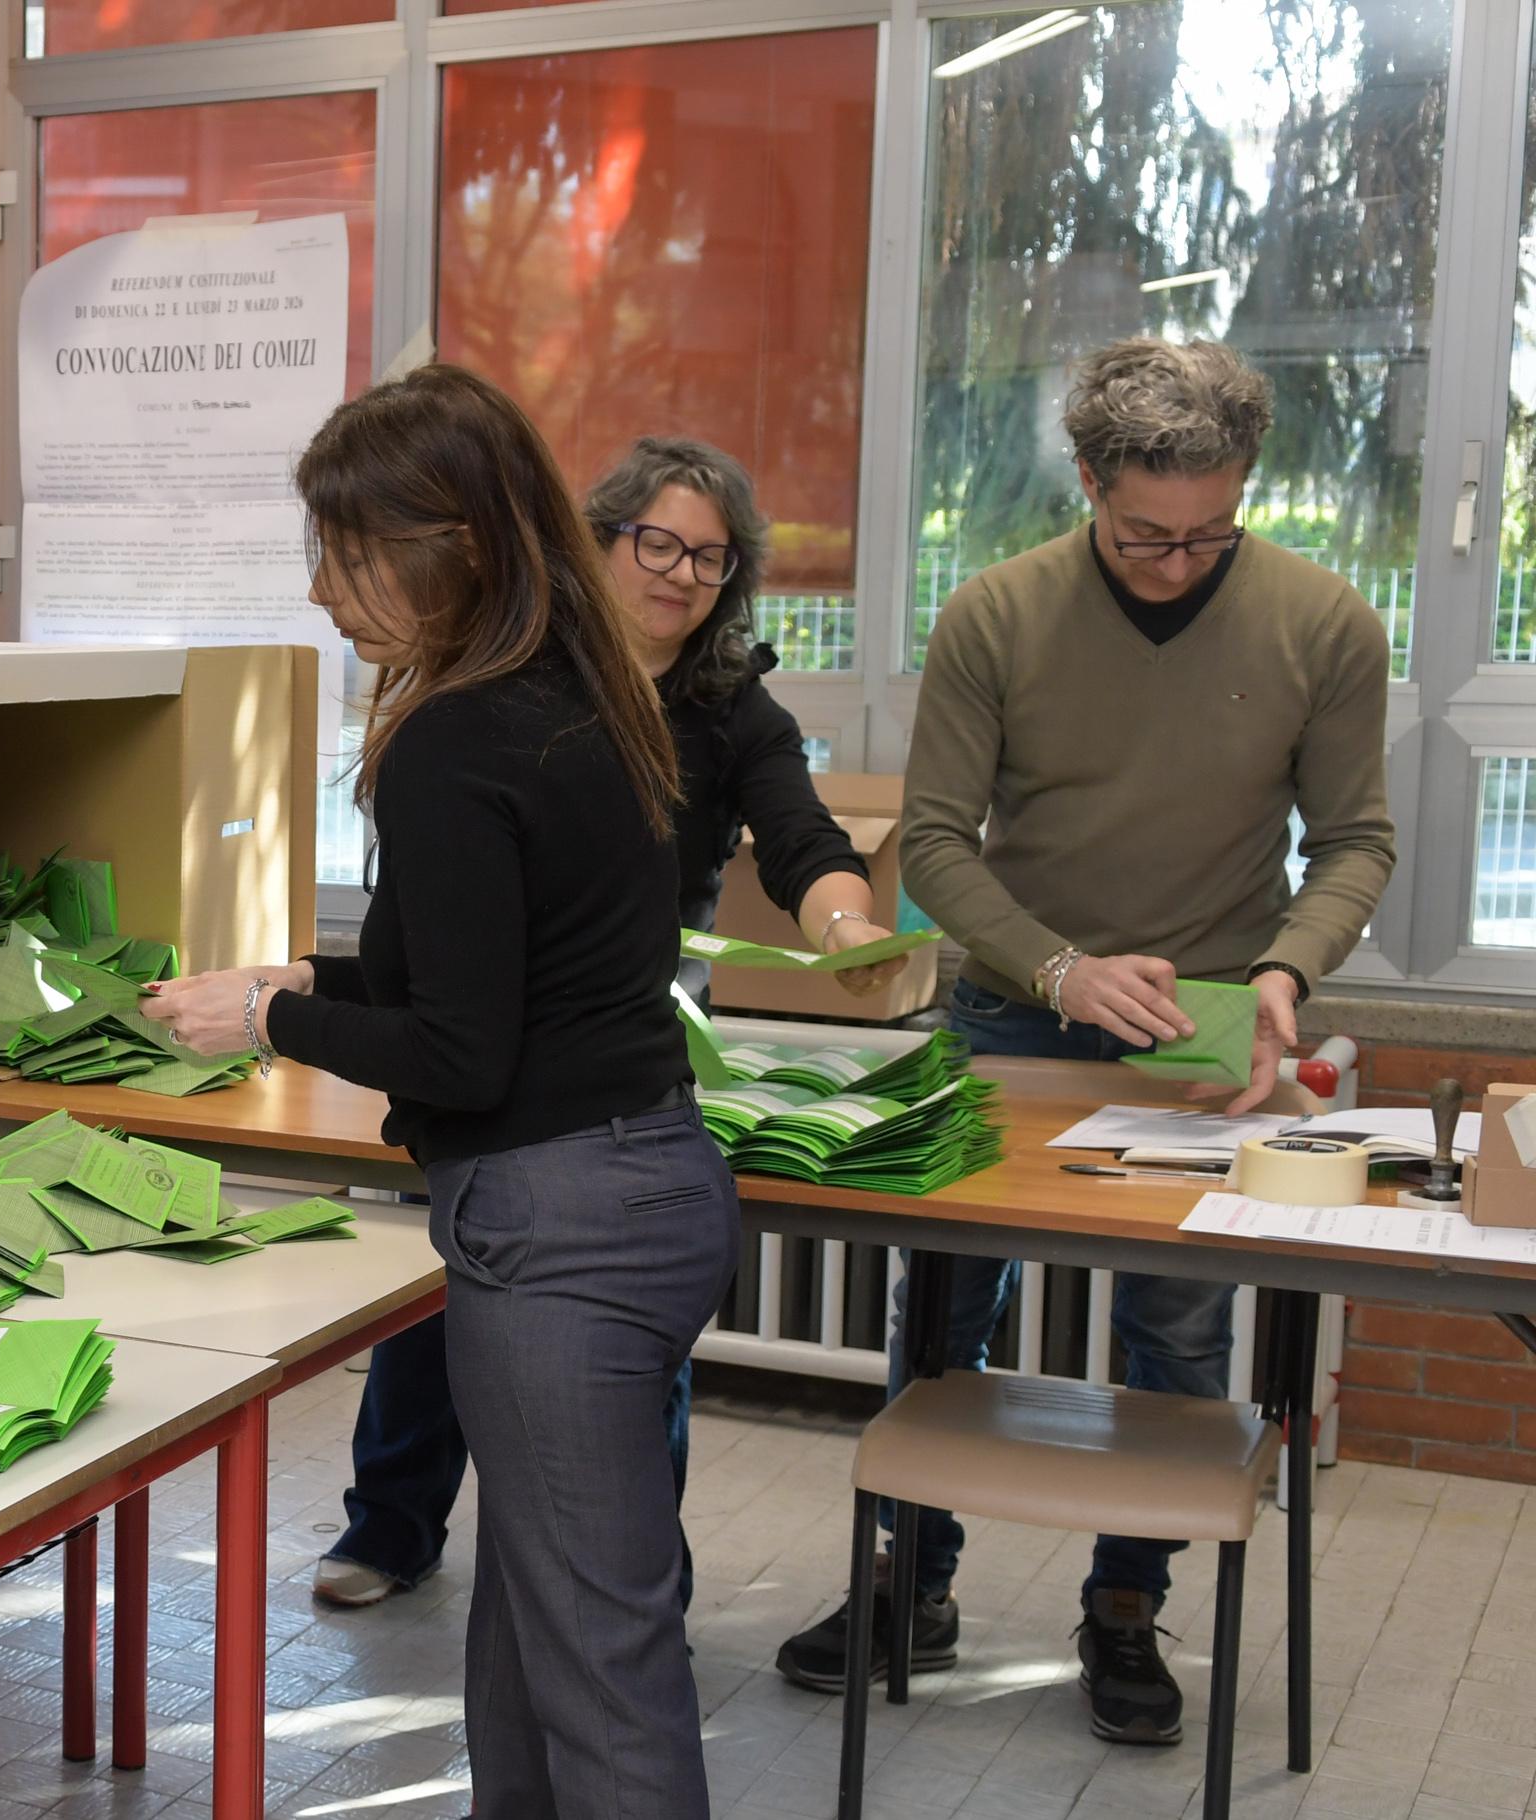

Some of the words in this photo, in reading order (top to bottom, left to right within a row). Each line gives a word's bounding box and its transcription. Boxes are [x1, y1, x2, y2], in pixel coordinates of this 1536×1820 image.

[111, 274, 183, 291] REFERENDUM
[189, 270, 276, 289] COSTITUZIONALE
[75, 305, 87, 319] DI
[91, 304, 149, 319] DOMENICA
[155, 303, 167, 317] 22
[172, 303, 179, 316] E
[186, 299, 222, 315] LUNEDÌ
[244, 298, 280, 313] MARZO
[56, 344, 206, 375] CONVOCAZIONE
[214, 342, 242, 371] DEI
[253, 338, 317, 369] COMIZI
